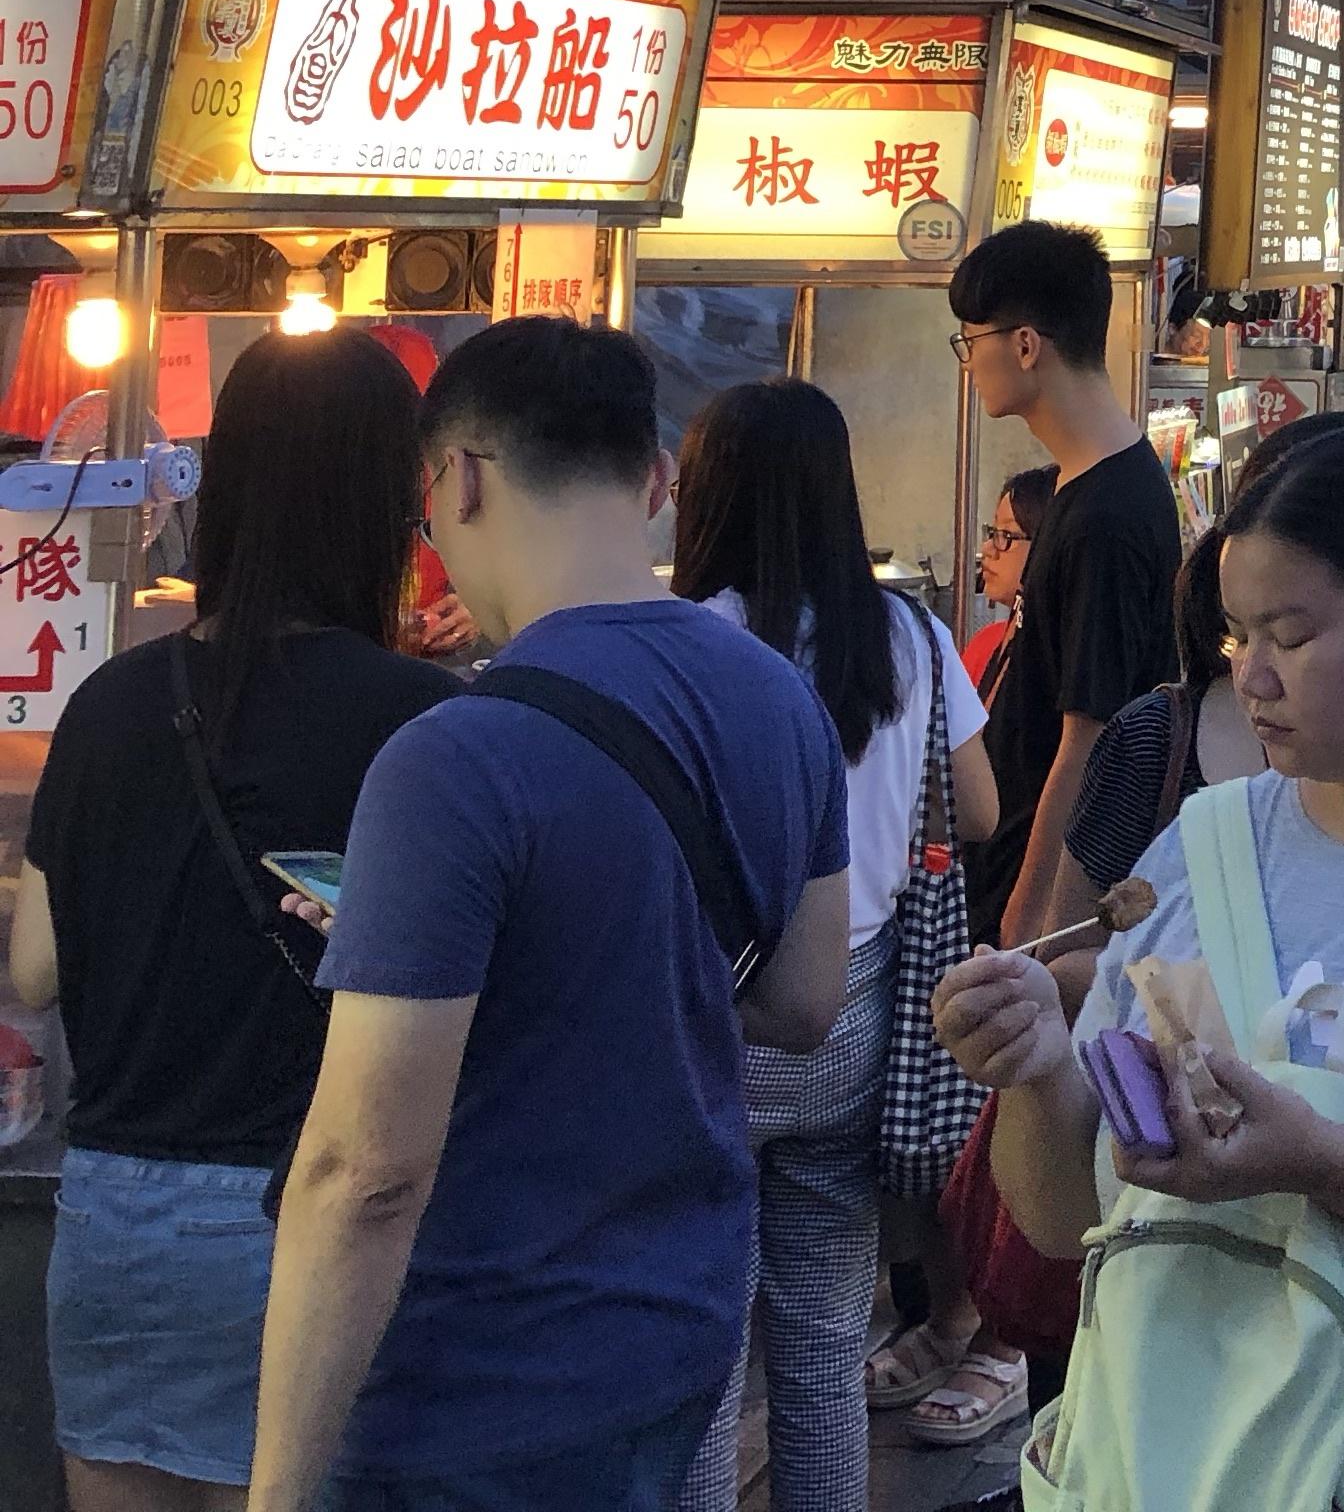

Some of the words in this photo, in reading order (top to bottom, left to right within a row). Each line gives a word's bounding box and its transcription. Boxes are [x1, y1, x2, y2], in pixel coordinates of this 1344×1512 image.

[632, 24, 665, 76] 1份
[833, 38, 988, 72] 魅力無限
[191, 77, 243, 117] 003
[612, 89, 660, 152] 50
[997, 179, 1023, 220] 005
[911, 220, 953, 240] FSI
[522, 278, 583, 310] 排隊順序
[0, 535, 82, 603] 隊
[73, 622, 89, 652] 1
[6, 694, 28, 725] 3
